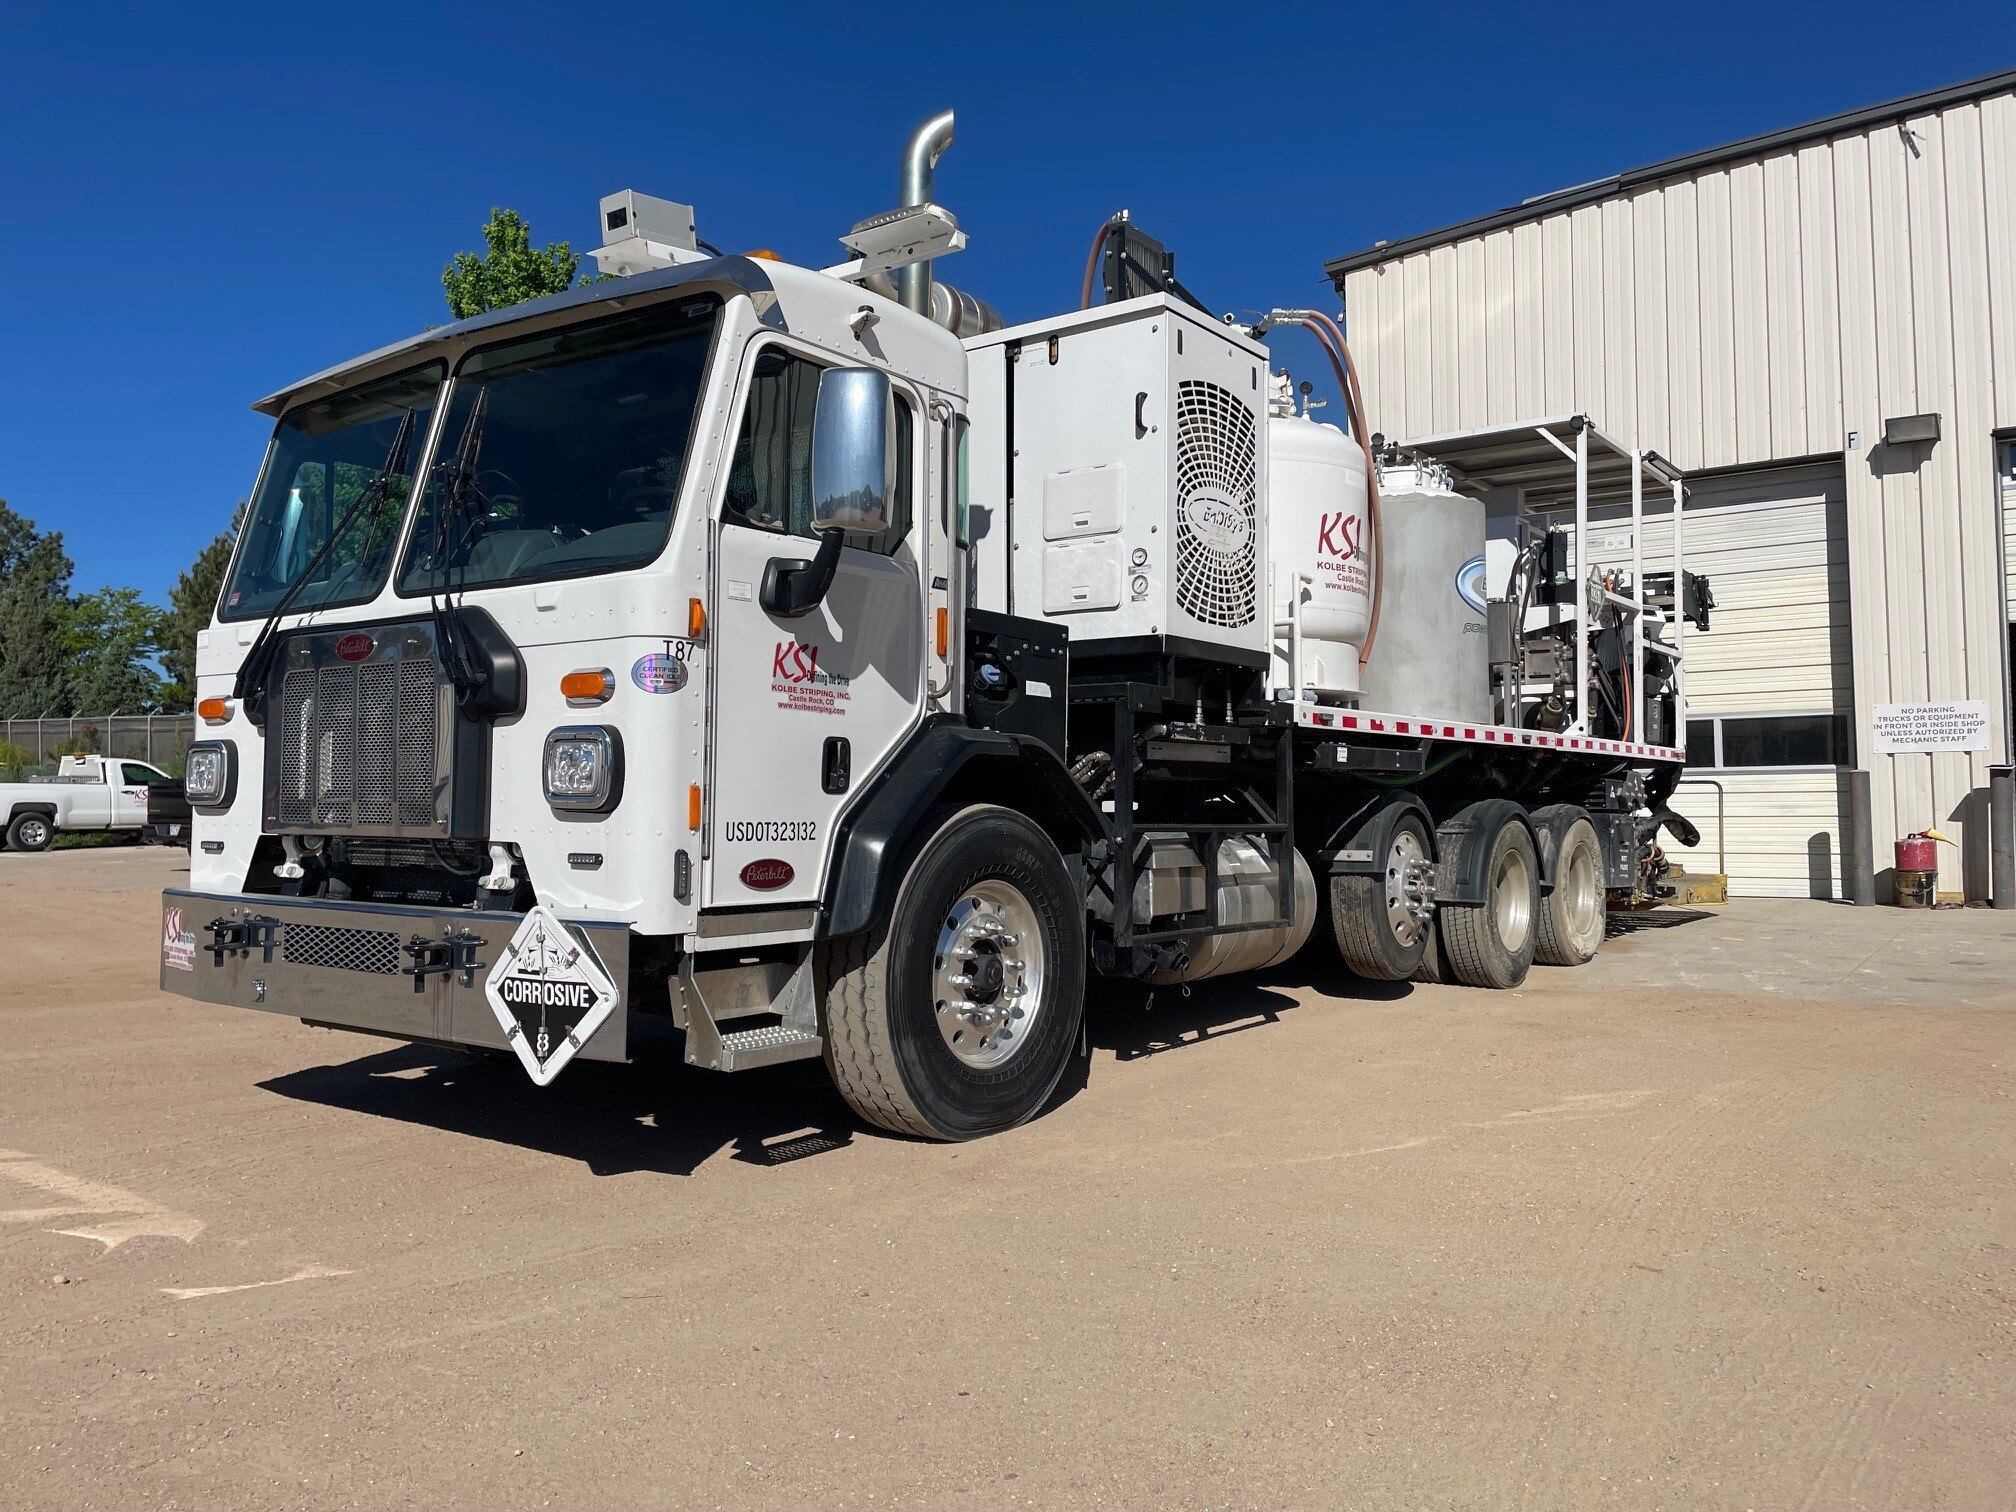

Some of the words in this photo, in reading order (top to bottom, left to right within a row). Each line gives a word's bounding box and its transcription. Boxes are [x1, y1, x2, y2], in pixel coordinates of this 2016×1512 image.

[1848, 431, 1858, 449] F
[1318, 511, 1362, 562] KSI
[1316, 561, 1346, 572] KOLBE
[663, 640, 695, 661] T87
[773, 641, 818, 684] KSI
[771, 684, 798, 694] KOLBE
[799, 687, 836, 699] STRIPING,
[837, 692, 851, 700] INC.
[788, 694, 807, 702] Castle
[808, 696, 824, 705] Rock,
[825, 698, 834, 706] CO
[778, 702, 846, 714] www.kolbestriping.com
[1916, 706, 1956, 714] PARKING
[1928, 713, 1979, 721] EQUIPMENT
[1892, 736, 1938, 744] MECHANIC
[134, 789, 148, 800] KS
[726, 821, 816, 842] USDOT323132
[746, 865, 791, 882] Peterbilt
[503, 979, 590, 1008] CORROSIVE
[537, 1033, 549, 1052] 8
